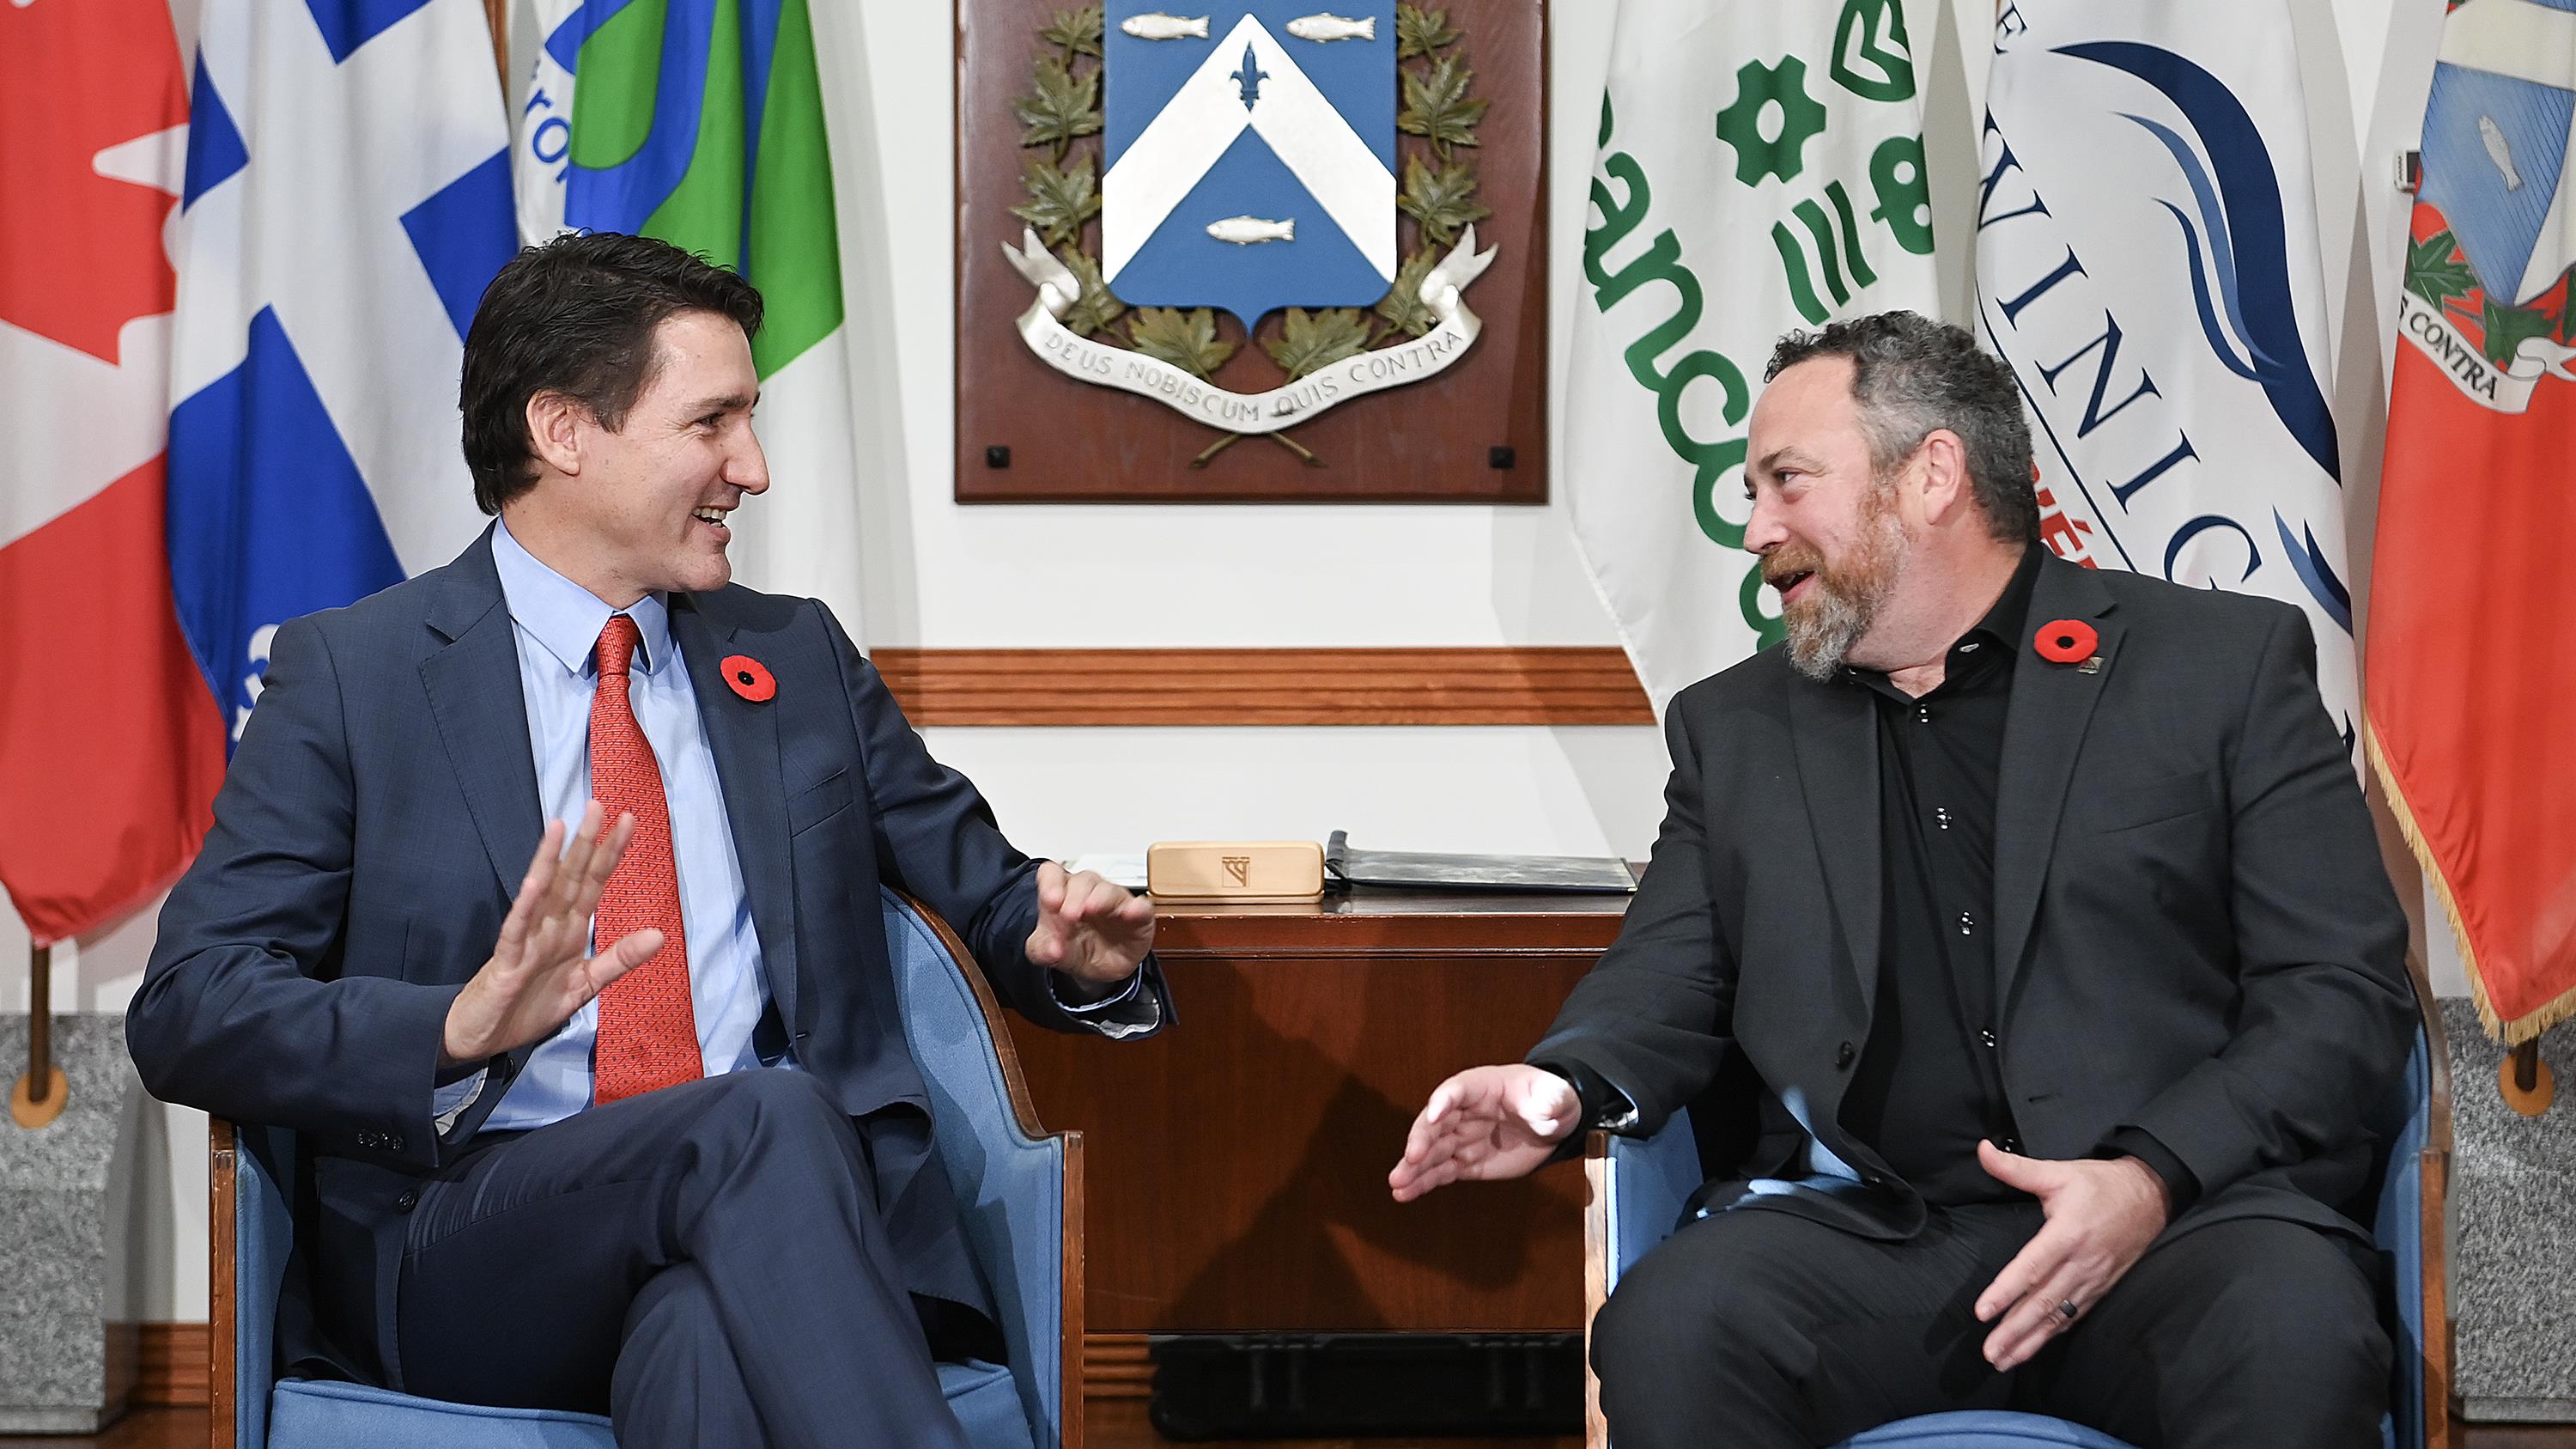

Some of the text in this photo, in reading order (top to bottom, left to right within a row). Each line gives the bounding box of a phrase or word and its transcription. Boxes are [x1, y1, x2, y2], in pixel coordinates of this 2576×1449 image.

[1044, 331, 1463, 422] DEUS NOBISCUM QUIS CONTRA
[2409, 311, 2498, 402] CONTRA
